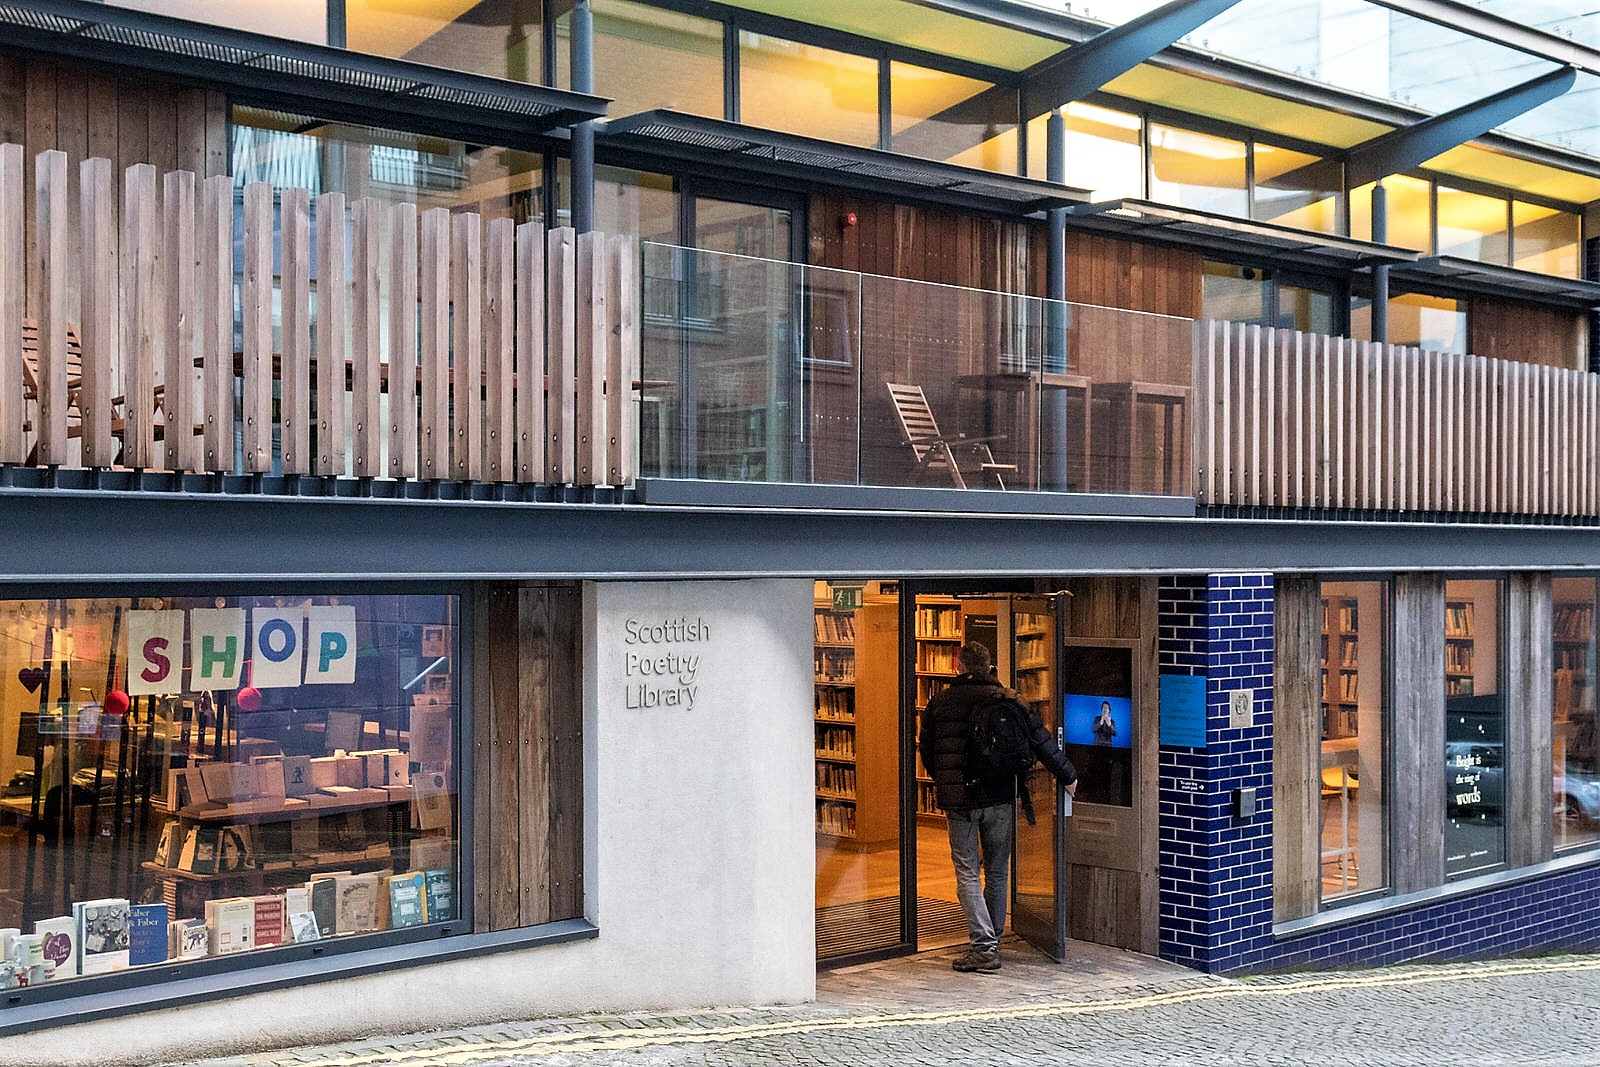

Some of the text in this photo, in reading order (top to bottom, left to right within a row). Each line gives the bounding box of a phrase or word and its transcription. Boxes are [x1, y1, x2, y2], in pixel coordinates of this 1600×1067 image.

[624, 617, 711, 645] Scottish
[141, 618, 349, 683] SHOP
[625, 651, 701, 686] Poetry
[625, 683, 698, 711] Library
[1456, 754, 1481, 770] Bright is
[1456, 786, 1480, 805] words
[137, 917, 159, 927] Faber
